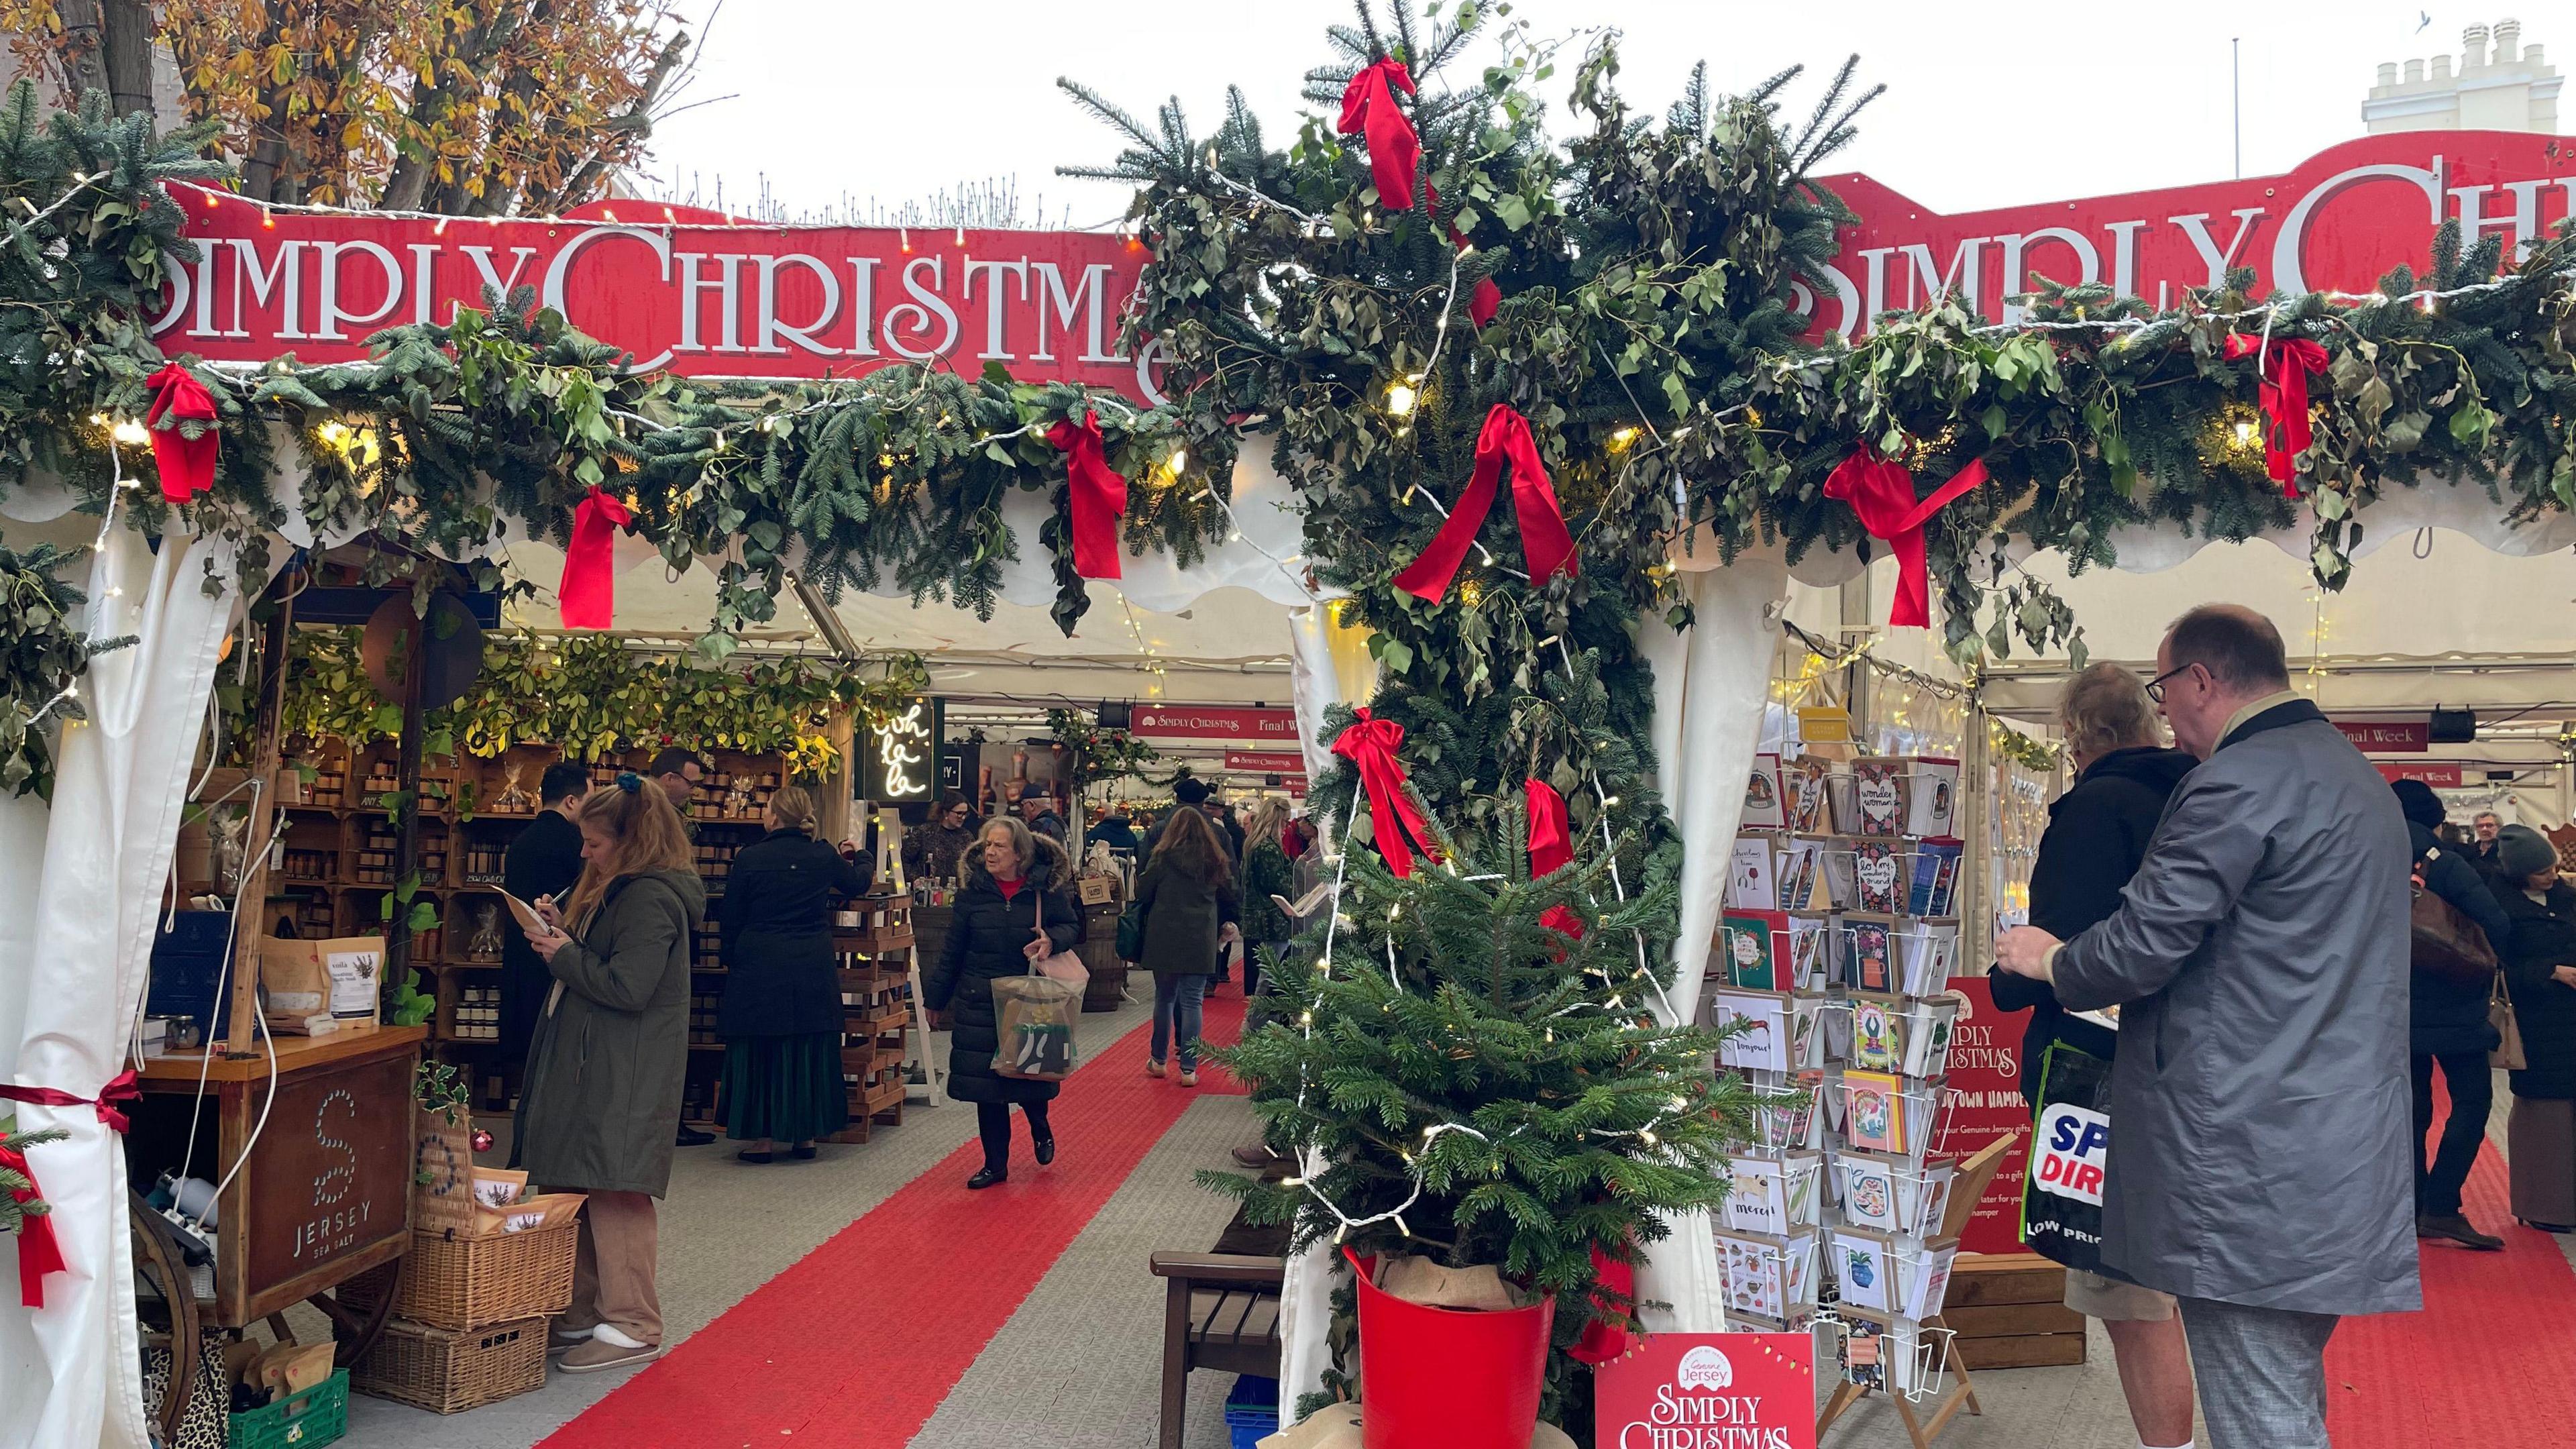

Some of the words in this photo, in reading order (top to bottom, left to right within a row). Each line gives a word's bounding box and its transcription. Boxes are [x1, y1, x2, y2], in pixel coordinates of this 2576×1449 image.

[1157, 714, 1189, 727] SIMPLY
[1190, 717, 1240, 732] CHRISTMAS
[1258, 719, 1285, 731] Final
[2373, 729, 2414, 743] Week
[885, 762, 926, 797] la
[2426, 772, 2453, 782] Week
[1958, 1091, 1984, 1108] OWN
[1988, 1090, 2029, 1108] HAMPE
[1960, 1124, 1990, 1134] Genuine
[1991, 1124, 2014, 1134] Jersey
[2015, 1123, 2031, 1136] gifts
[1926, 1150, 1954, 1158] Choose
[2010, 1172, 2024, 1182] gift
[1980, 1195, 1998, 1203] later
[1998, 1194, 2009, 1203] for
[293, 1199, 371, 1258] JERSEY
[2027, 1220, 2061, 1236] LOW
[313, 1244, 329, 1259] SEA
[334, 1233, 355, 1250] SALT
[1682, 1368, 1728, 1384] Jersey
[1650, 1383, 1762, 1426] SIMPLY
